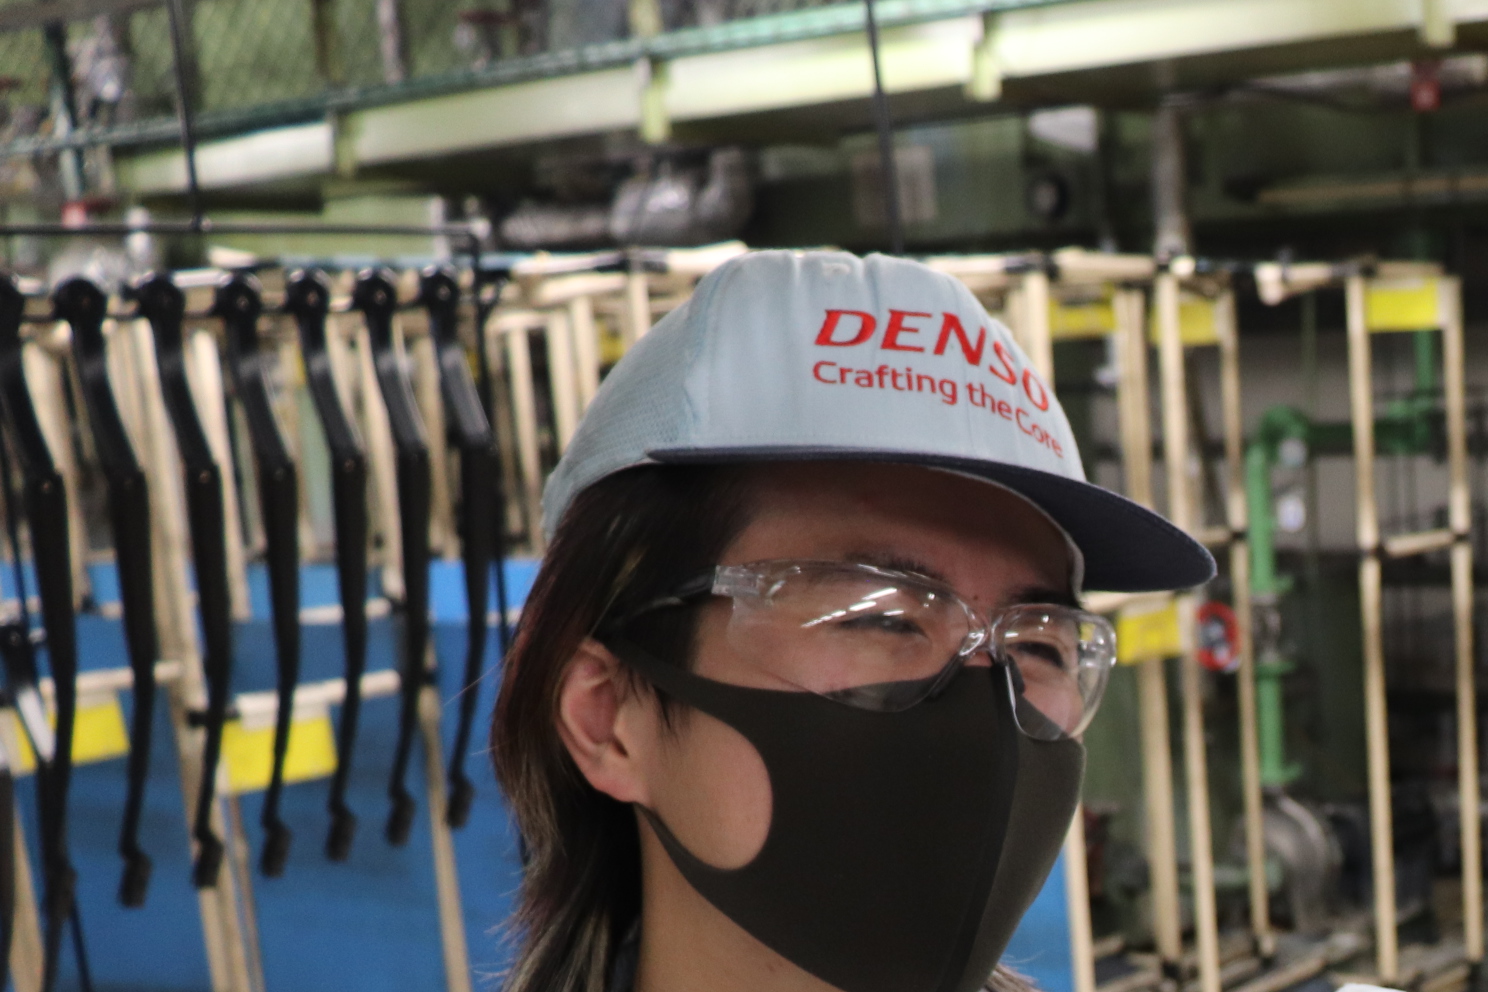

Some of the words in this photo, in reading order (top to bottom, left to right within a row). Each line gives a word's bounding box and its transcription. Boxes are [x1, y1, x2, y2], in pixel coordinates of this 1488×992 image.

[812, 360, 959, 406] Crafting
[965, 383, 1013, 421] the
[1015, 407, 1064, 459] Core
[814, 309, 1050, 412] DENSO
